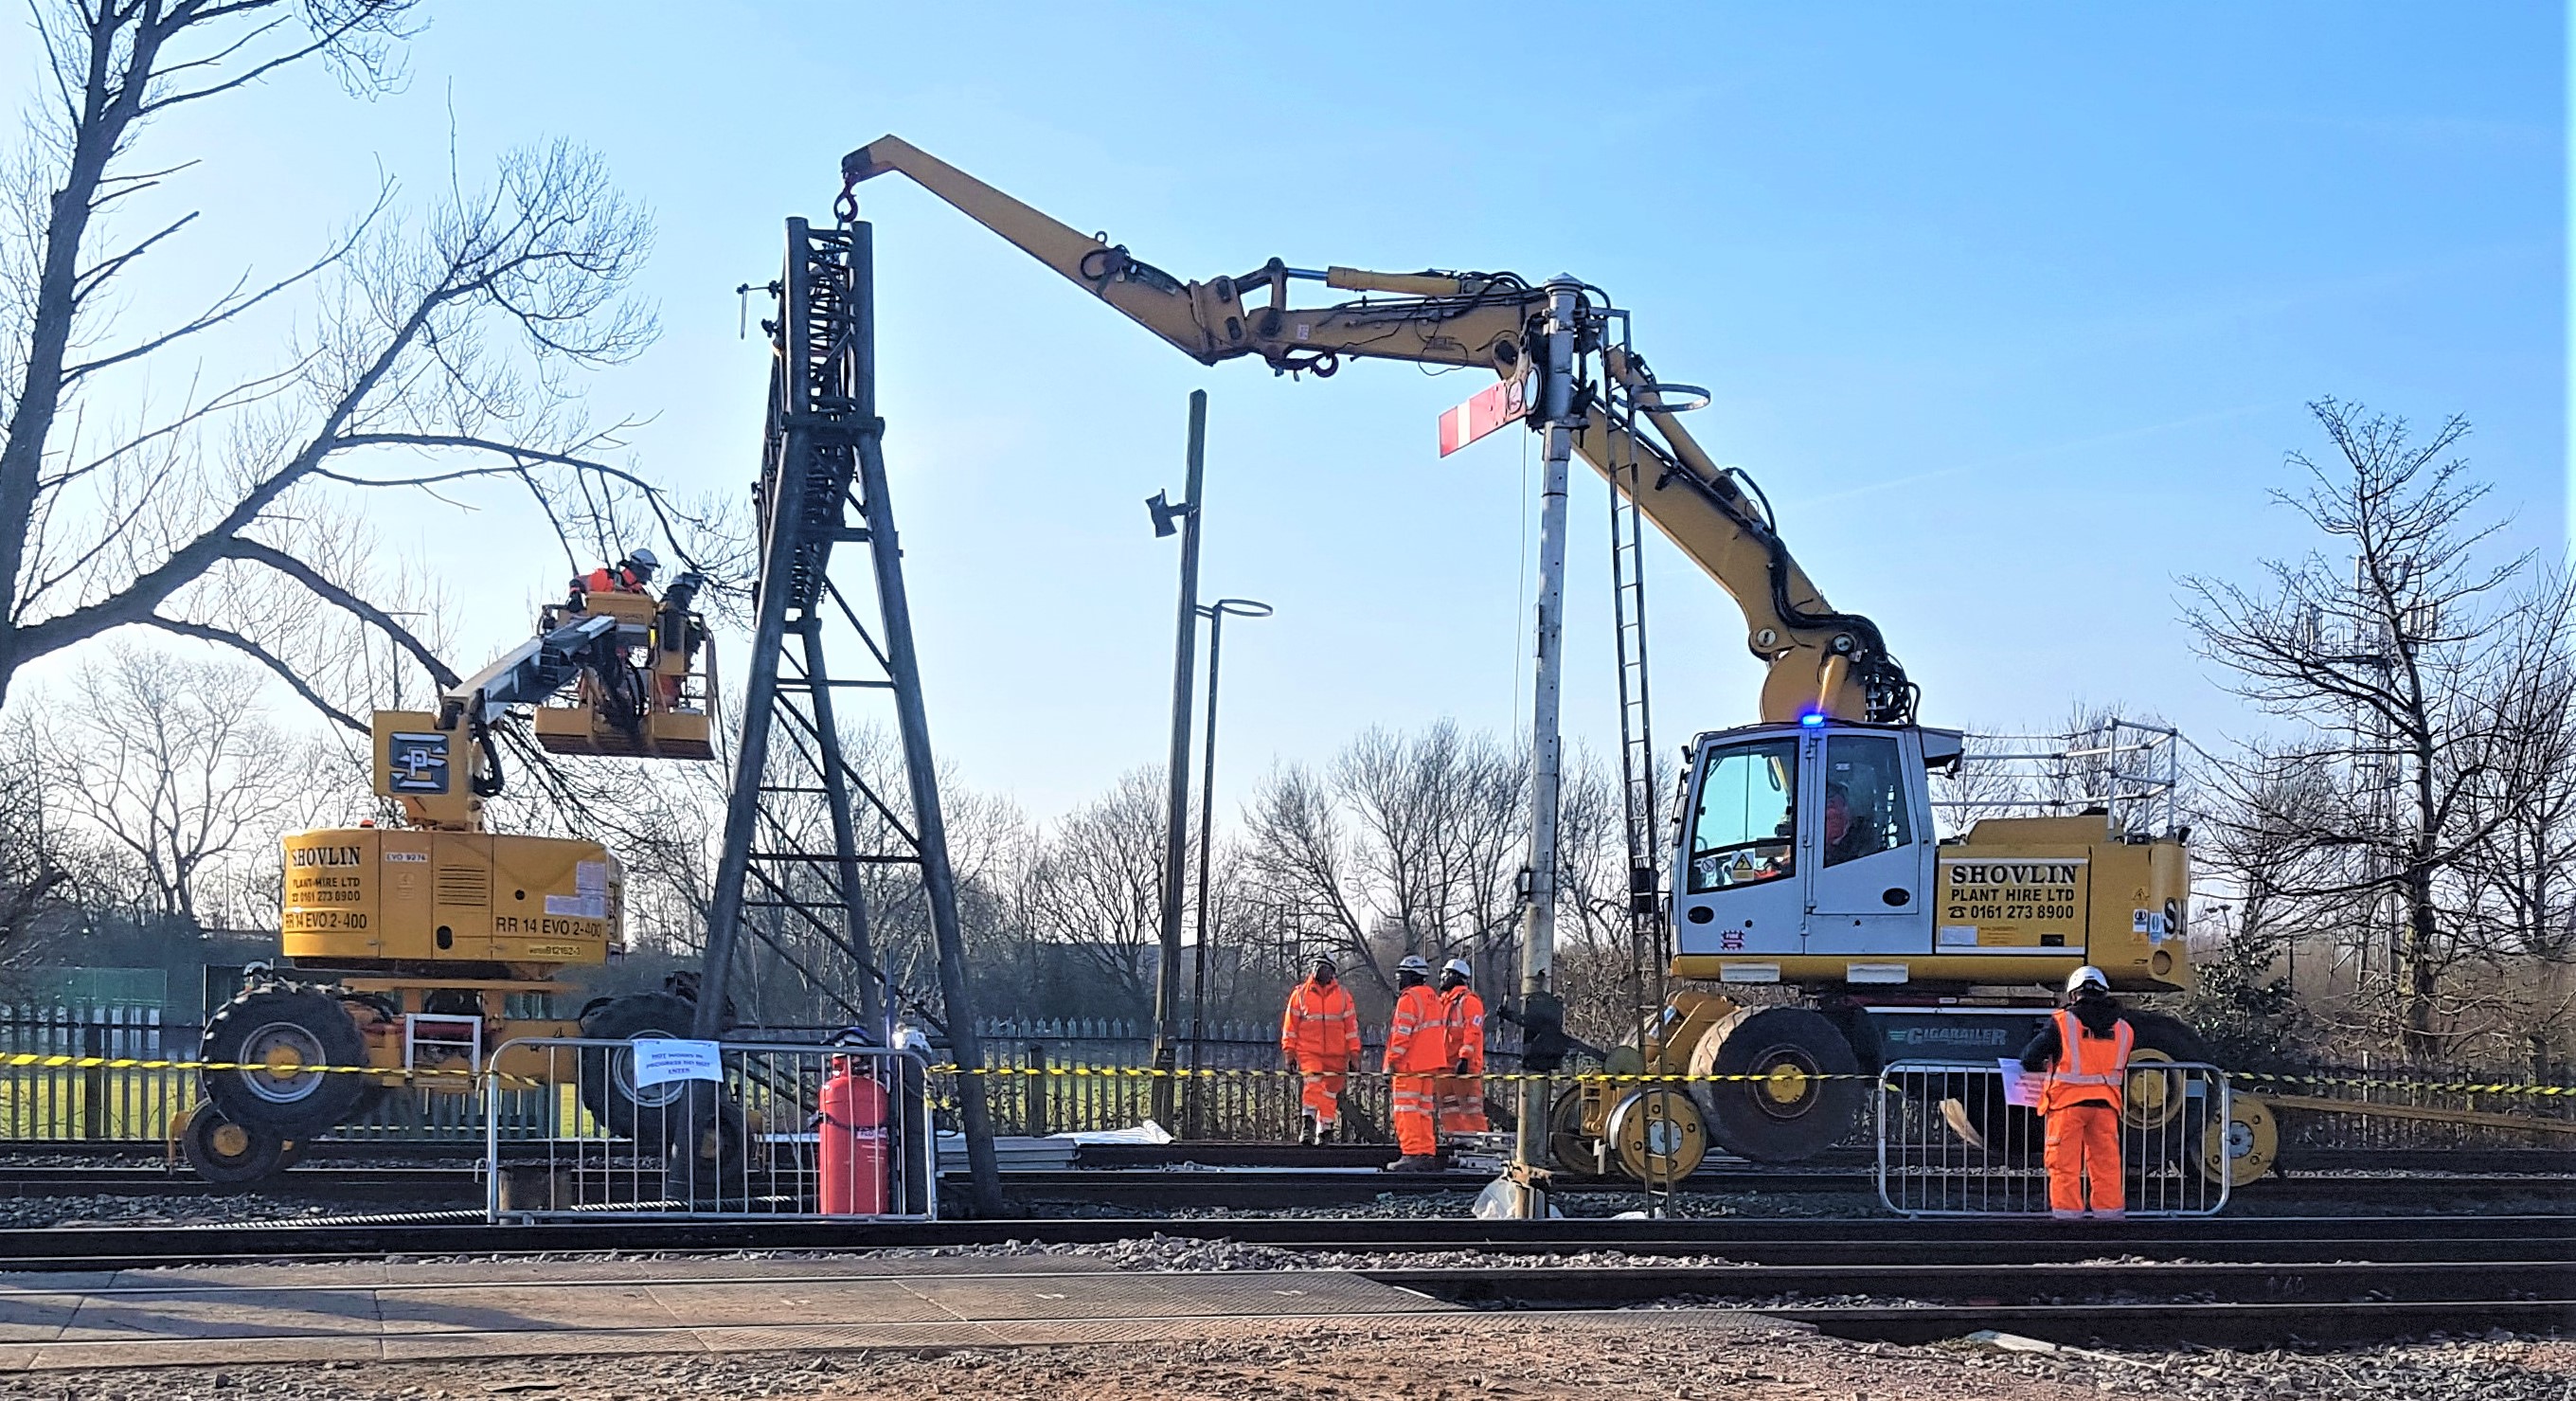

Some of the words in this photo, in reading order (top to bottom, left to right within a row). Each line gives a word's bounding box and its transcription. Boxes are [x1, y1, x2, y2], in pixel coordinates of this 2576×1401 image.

[292, 847, 361, 867] SHOVLIN
[1951, 864, 2078, 885] SHOVLIN
[315, 877, 338, 888] HIRE
[341, 877, 361, 888] LTD
[317, 891, 332, 902] 273
[335, 890, 361, 902] 8900
[1951, 889, 1999, 902] PLANT
[2006, 889, 2042, 902] HIRE
[2047, 889, 2075, 902] LTD
[1970, 905, 2002, 919] 0161
[2007, 905, 2033, 919] 273
[2037, 905, 2074, 919] 8900
[306, 913, 328, 928] EVO
[330, 912, 367, 929] 2-400
[495, 916, 518, 933] RR
[523, 919, 537, 934] 14
[542, 919, 570, 935] EVO
[572, 921, 602, 938] 2-400
